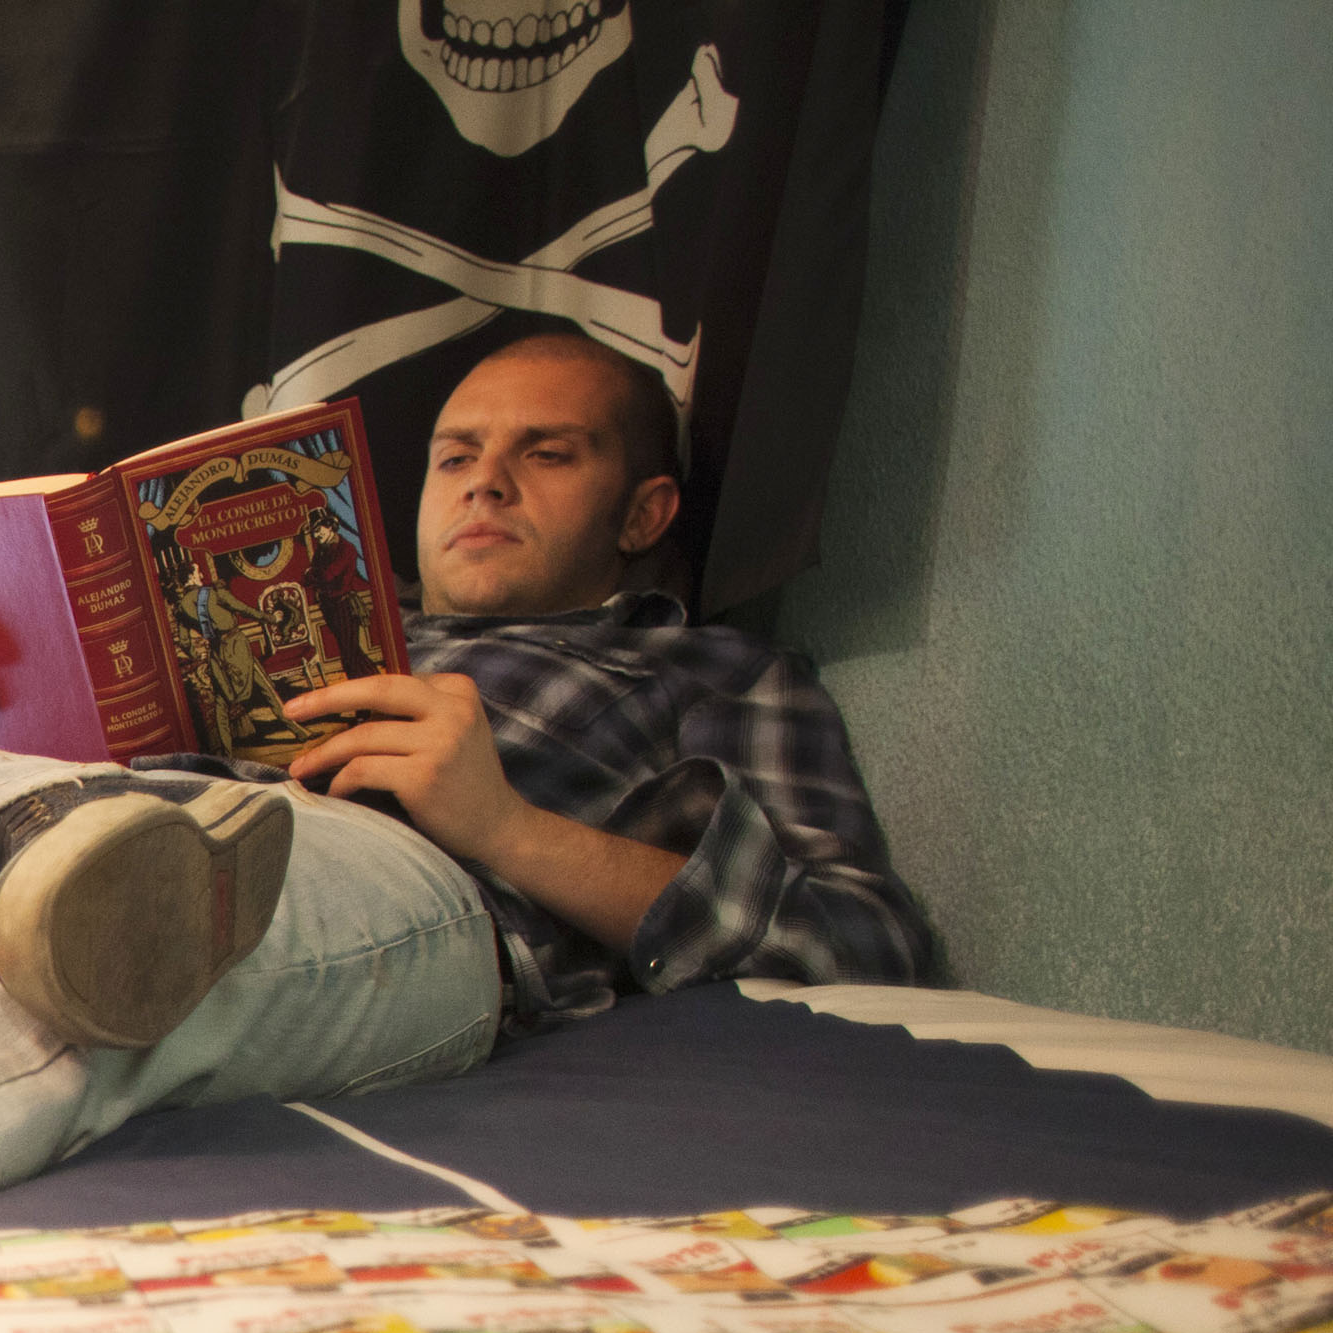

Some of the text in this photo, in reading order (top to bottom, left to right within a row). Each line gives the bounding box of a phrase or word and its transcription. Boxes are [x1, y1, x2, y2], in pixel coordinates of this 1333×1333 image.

[164, 452, 301, 521] ALEJANDRO DUMAS
[198, 493, 294, 528] EL CONDE DE
[191, 507, 297, 545] MONTECRISTO
[77, 579, 132, 606] ALEJANDRO
[89, 594, 126, 614] DUMAS
[107, 710, 158, 733] MONTECRISTO
[110, 701, 158, 724] EL CONDE DE
